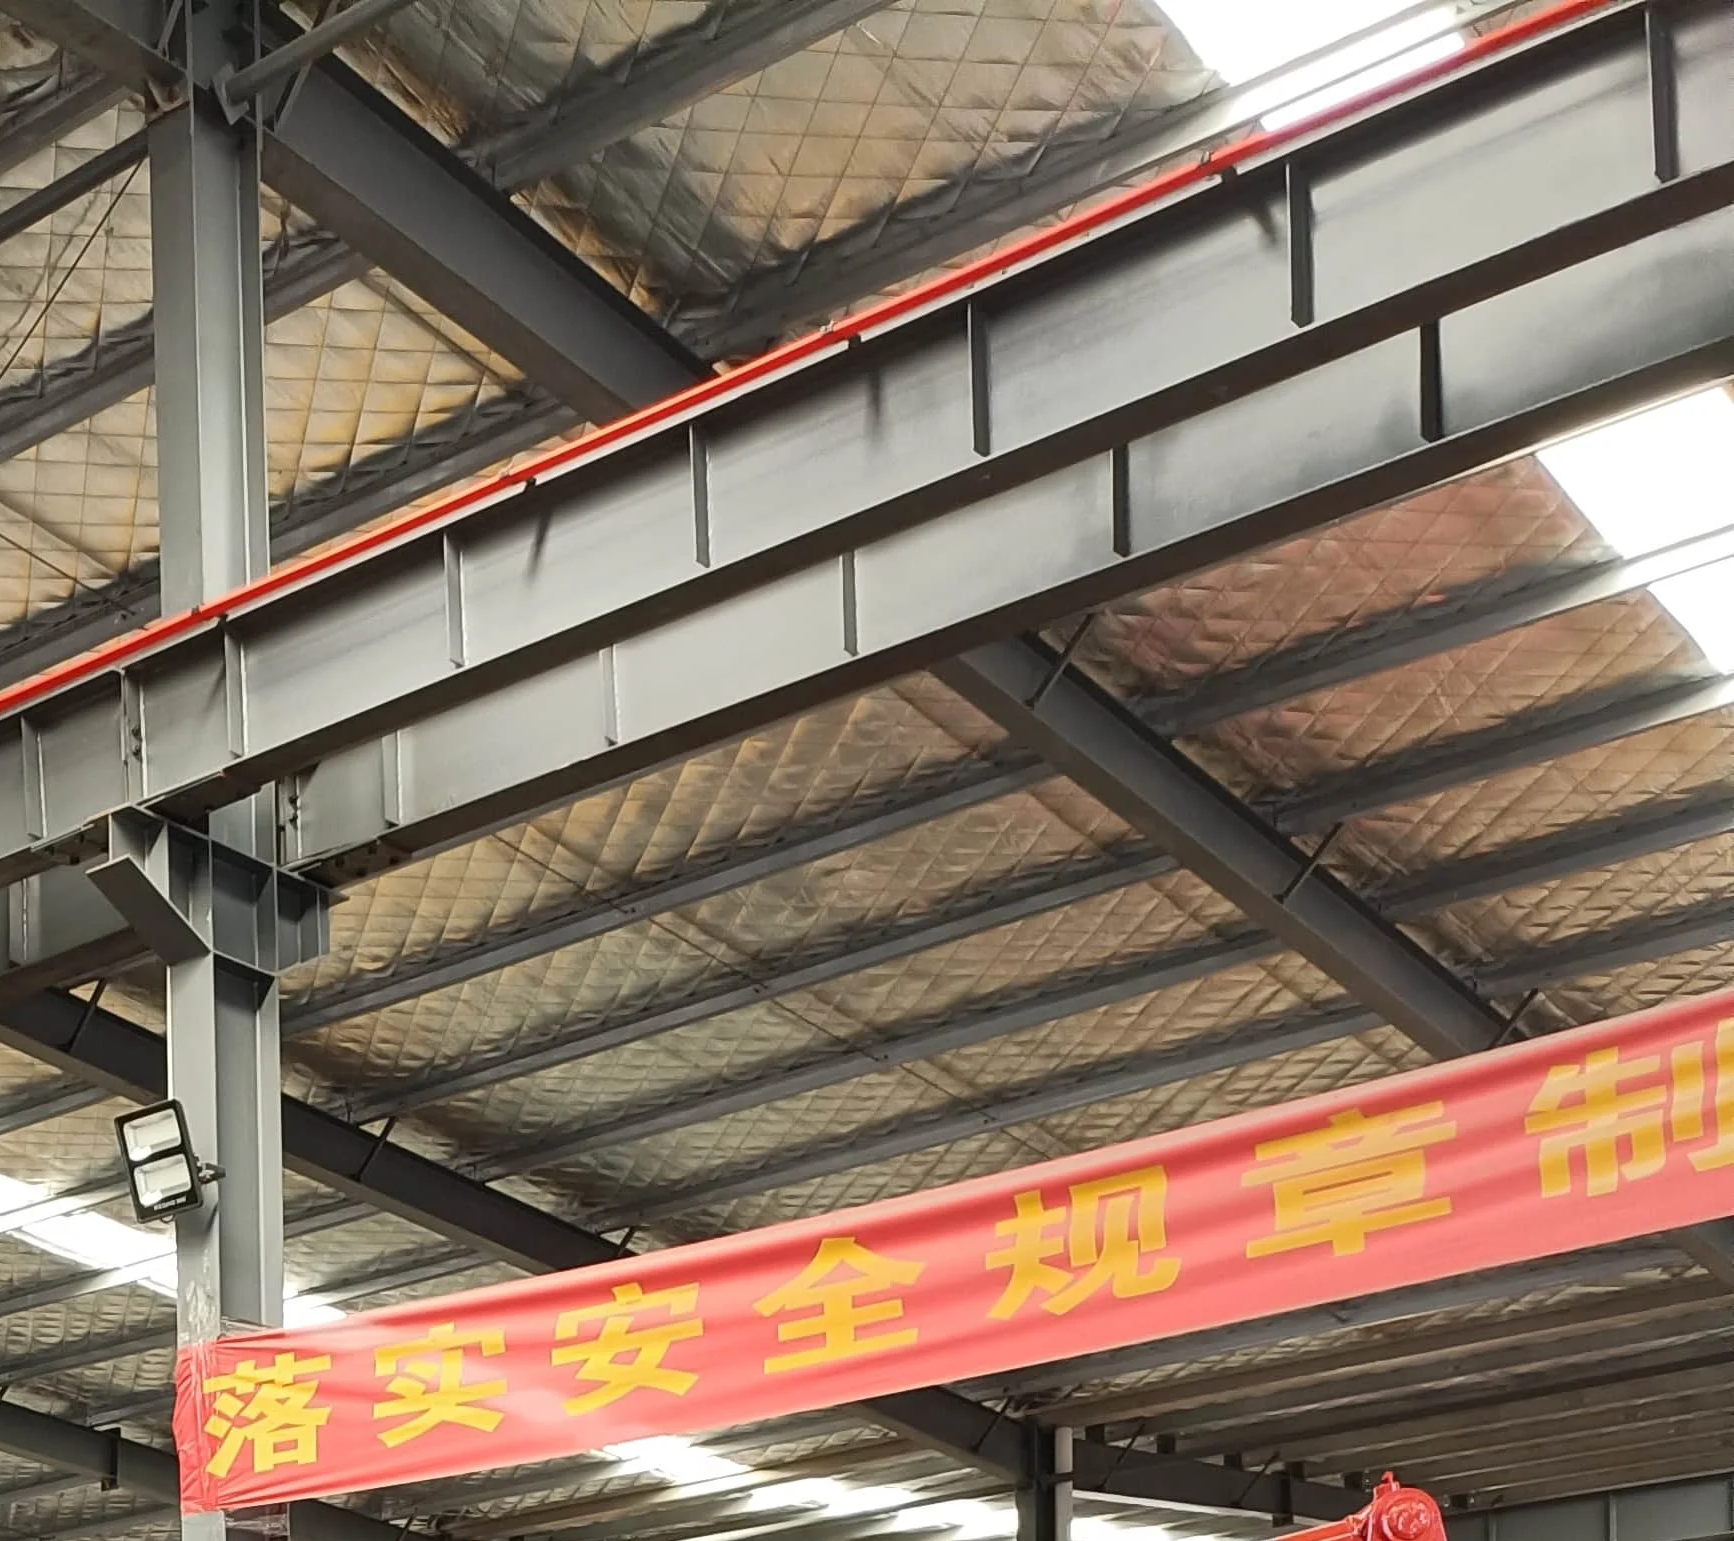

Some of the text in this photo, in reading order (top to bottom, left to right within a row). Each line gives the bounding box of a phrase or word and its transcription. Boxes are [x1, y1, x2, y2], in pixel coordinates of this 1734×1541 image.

[203, 1016, 1734, 1478] 落实安全规章制
